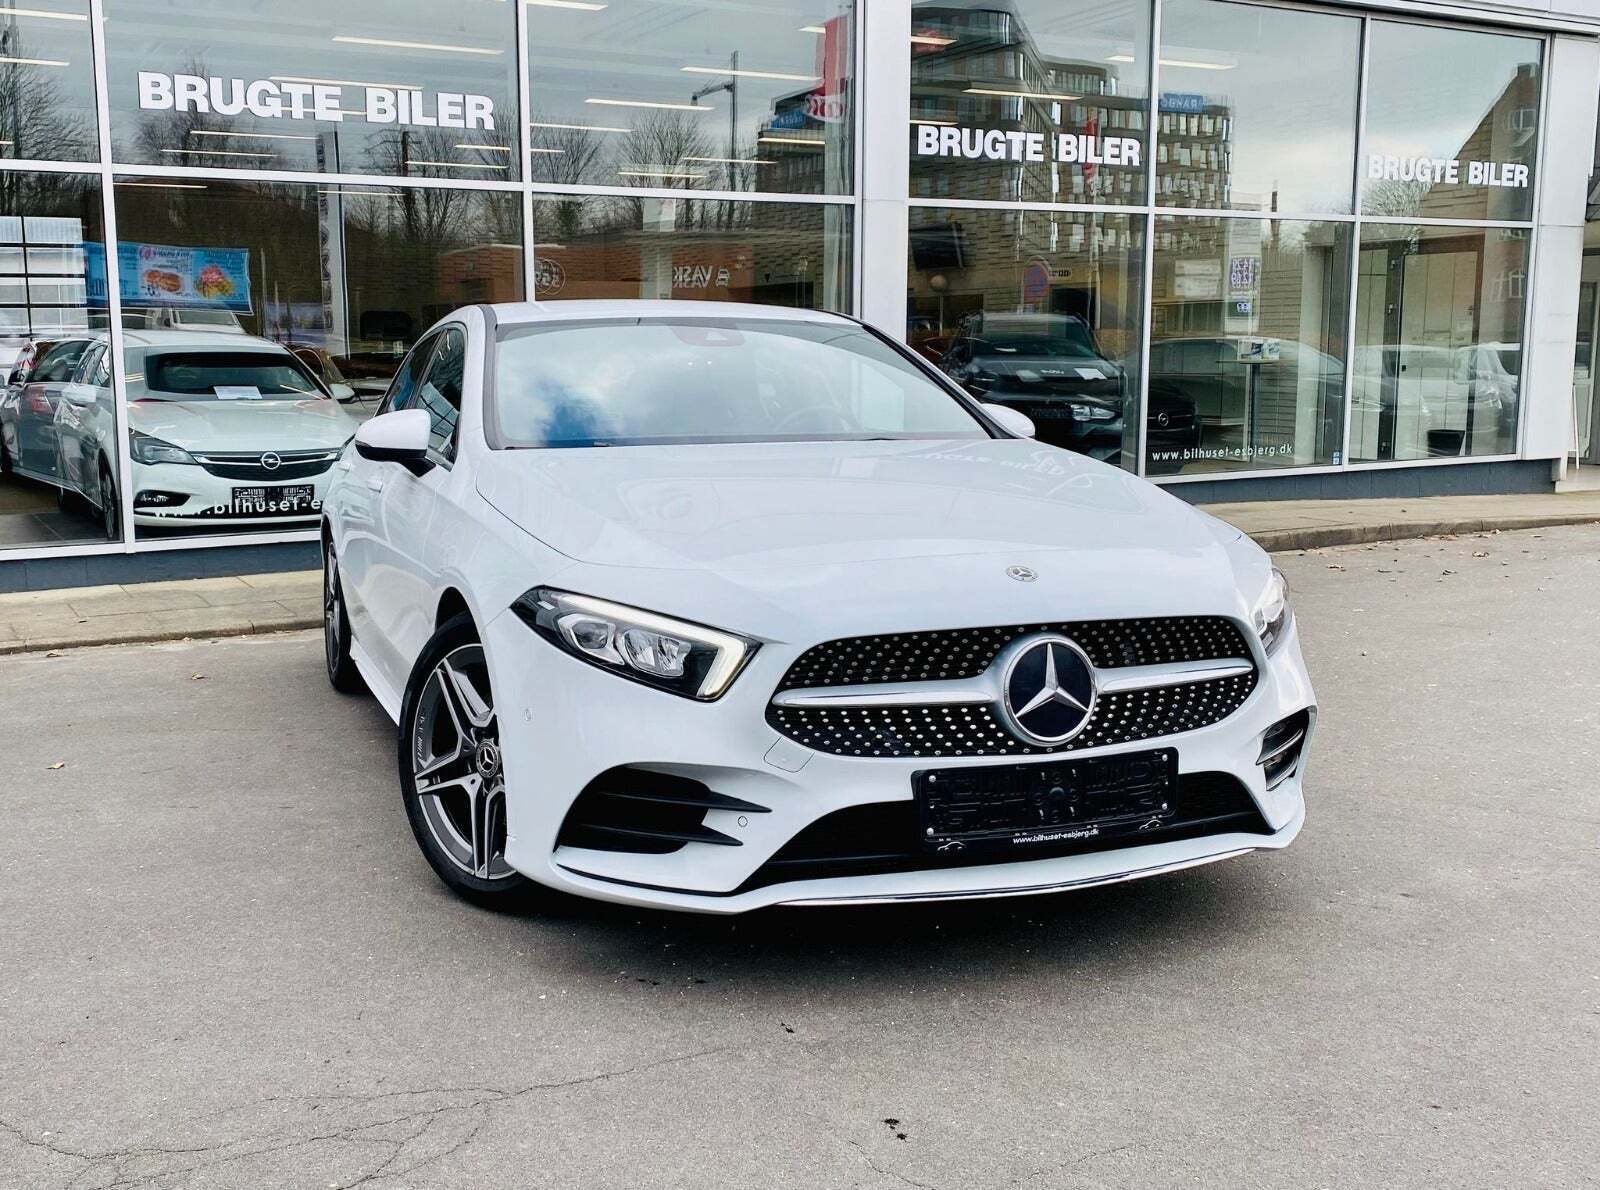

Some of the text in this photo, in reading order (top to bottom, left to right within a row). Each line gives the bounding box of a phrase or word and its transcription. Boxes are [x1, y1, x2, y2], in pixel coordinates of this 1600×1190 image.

[137, 71, 495, 130] BRUGTE BILER
[917, 125, 1140, 166] BRUGTE BILER
[1368, 154, 1529, 188] BRUGTE BILER
[1152, 443, 1293, 461] www.bilhuset-esbjerg.dk
